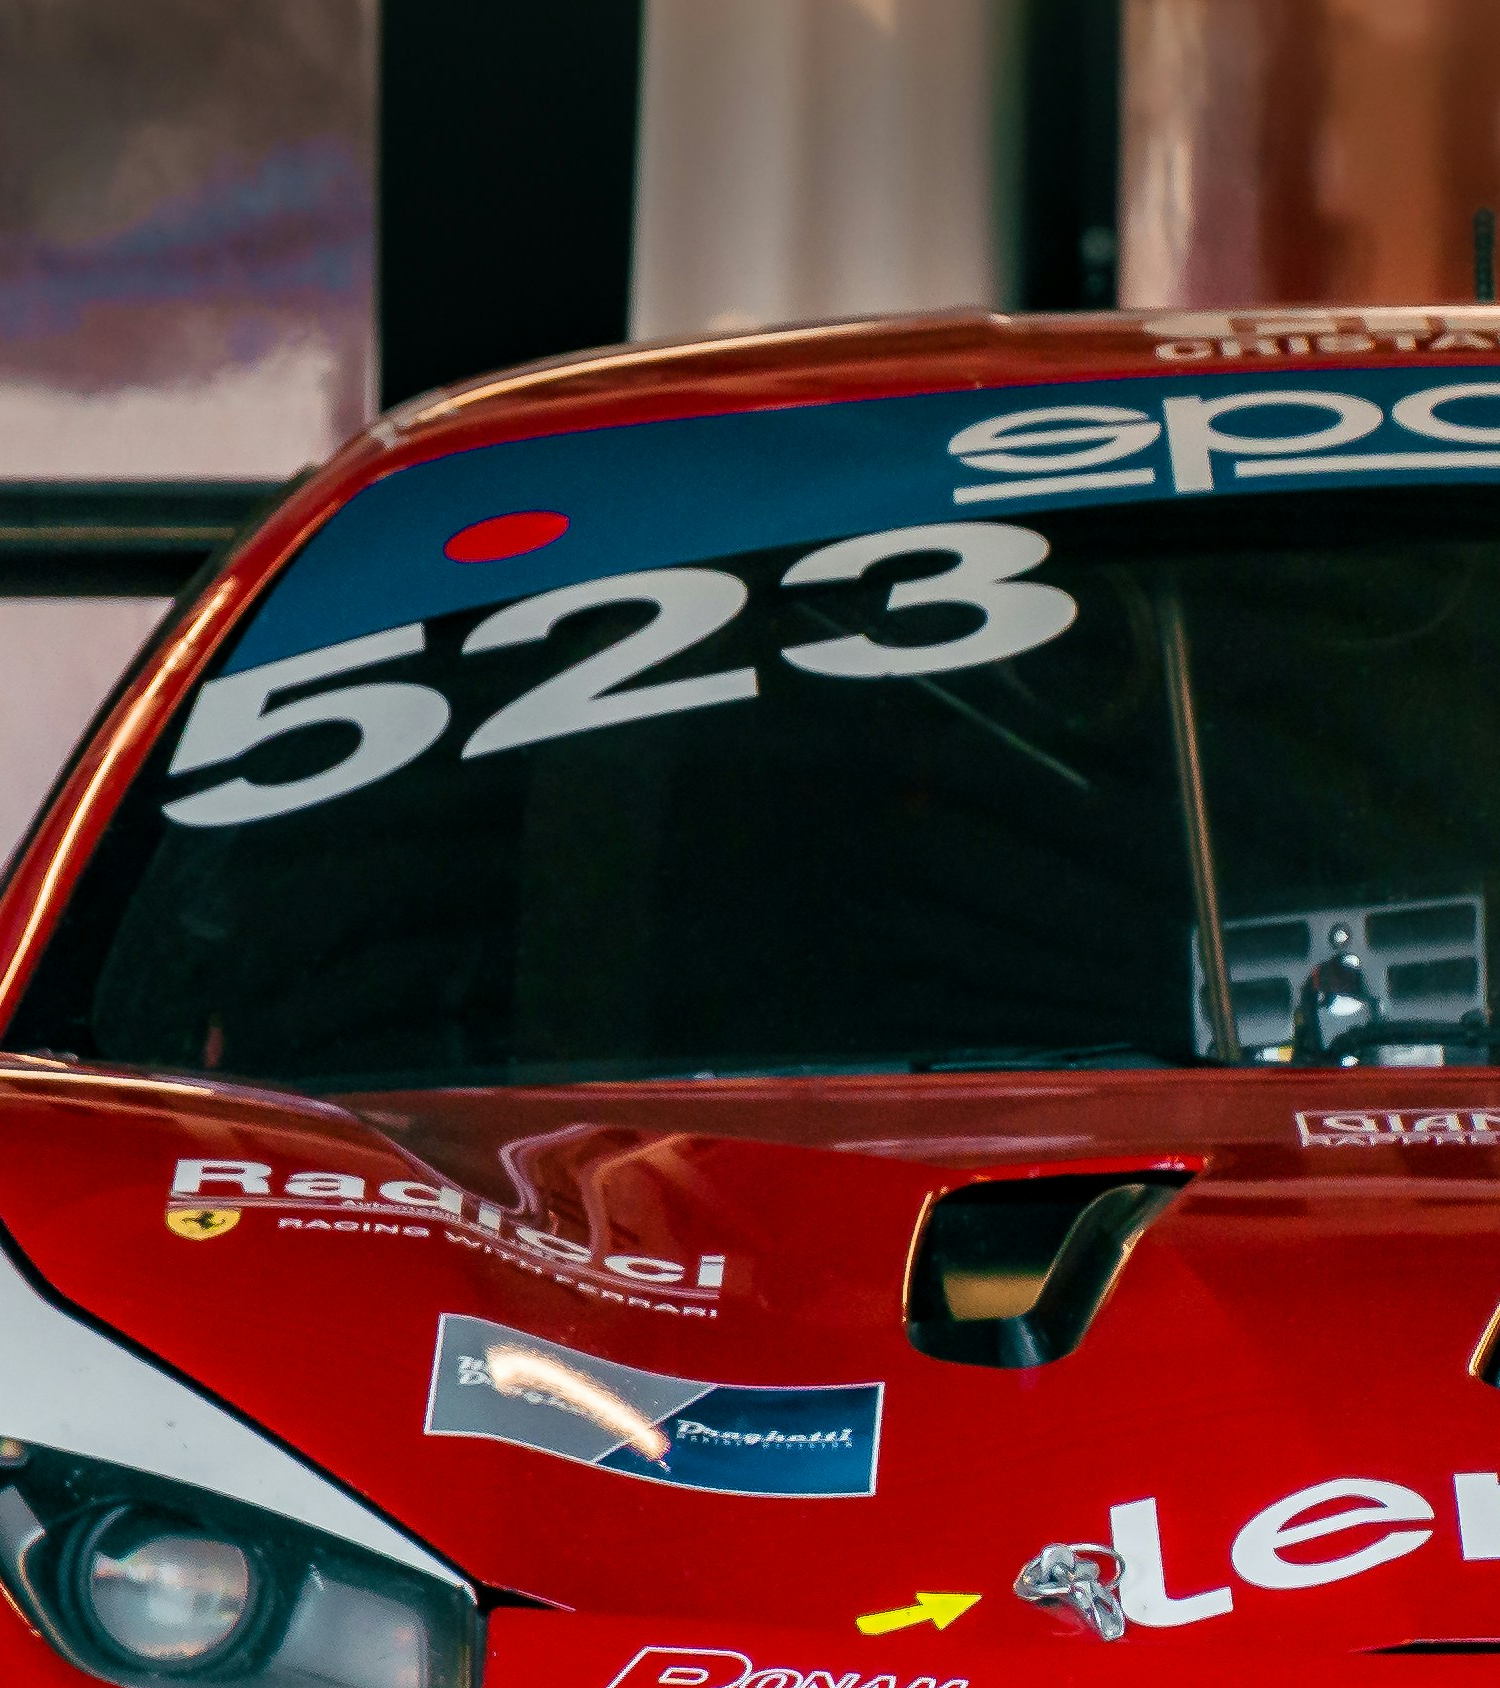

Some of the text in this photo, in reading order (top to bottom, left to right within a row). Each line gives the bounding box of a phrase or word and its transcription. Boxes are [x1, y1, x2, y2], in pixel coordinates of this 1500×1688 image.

[161, 520, 1080, 828] 523
[169, 1157, 727, 1289] Radicci
[277, 1216, 432, 1239] RACING
[554, 1272, 719, 1319] FERRARI
